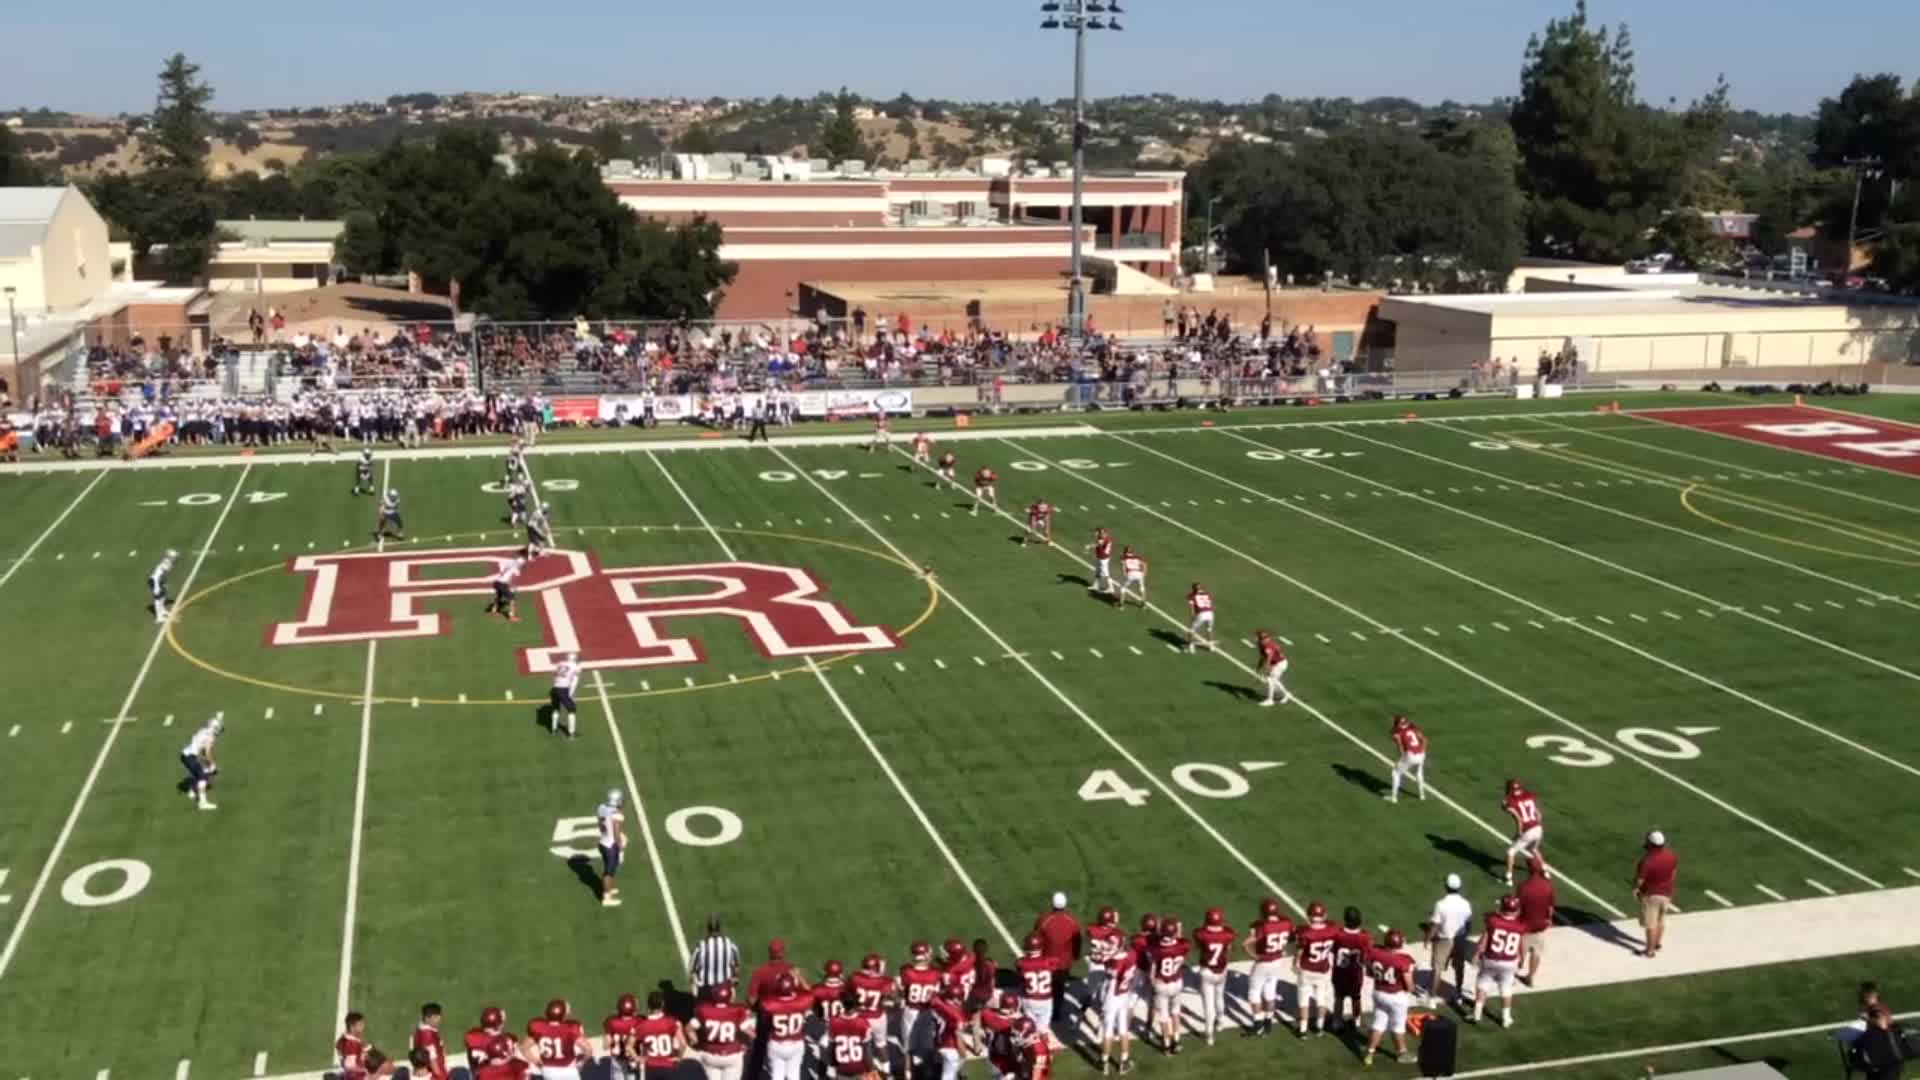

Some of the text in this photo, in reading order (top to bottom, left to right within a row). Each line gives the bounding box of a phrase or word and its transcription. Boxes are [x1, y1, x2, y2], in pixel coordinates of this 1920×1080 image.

[1526, 727, 1702, 767] 30
[1078, 763, 1250, 807] 40
[1517, 799, 1536, 822] 17
[550, 806, 743, 859] 50
[1491, 929, 1521, 955] 58
[1208, 943, 1223, 966] 7
[1023, 970, 1052, 994] 32
[1372, 961, 1397, 984] 64
[772, 1013, 803, 1037] 50
[539, 1038, 565, 1058] 61
[644, 1034, 672, 1057] 30
[835, 1035, 863, 1062] 26
